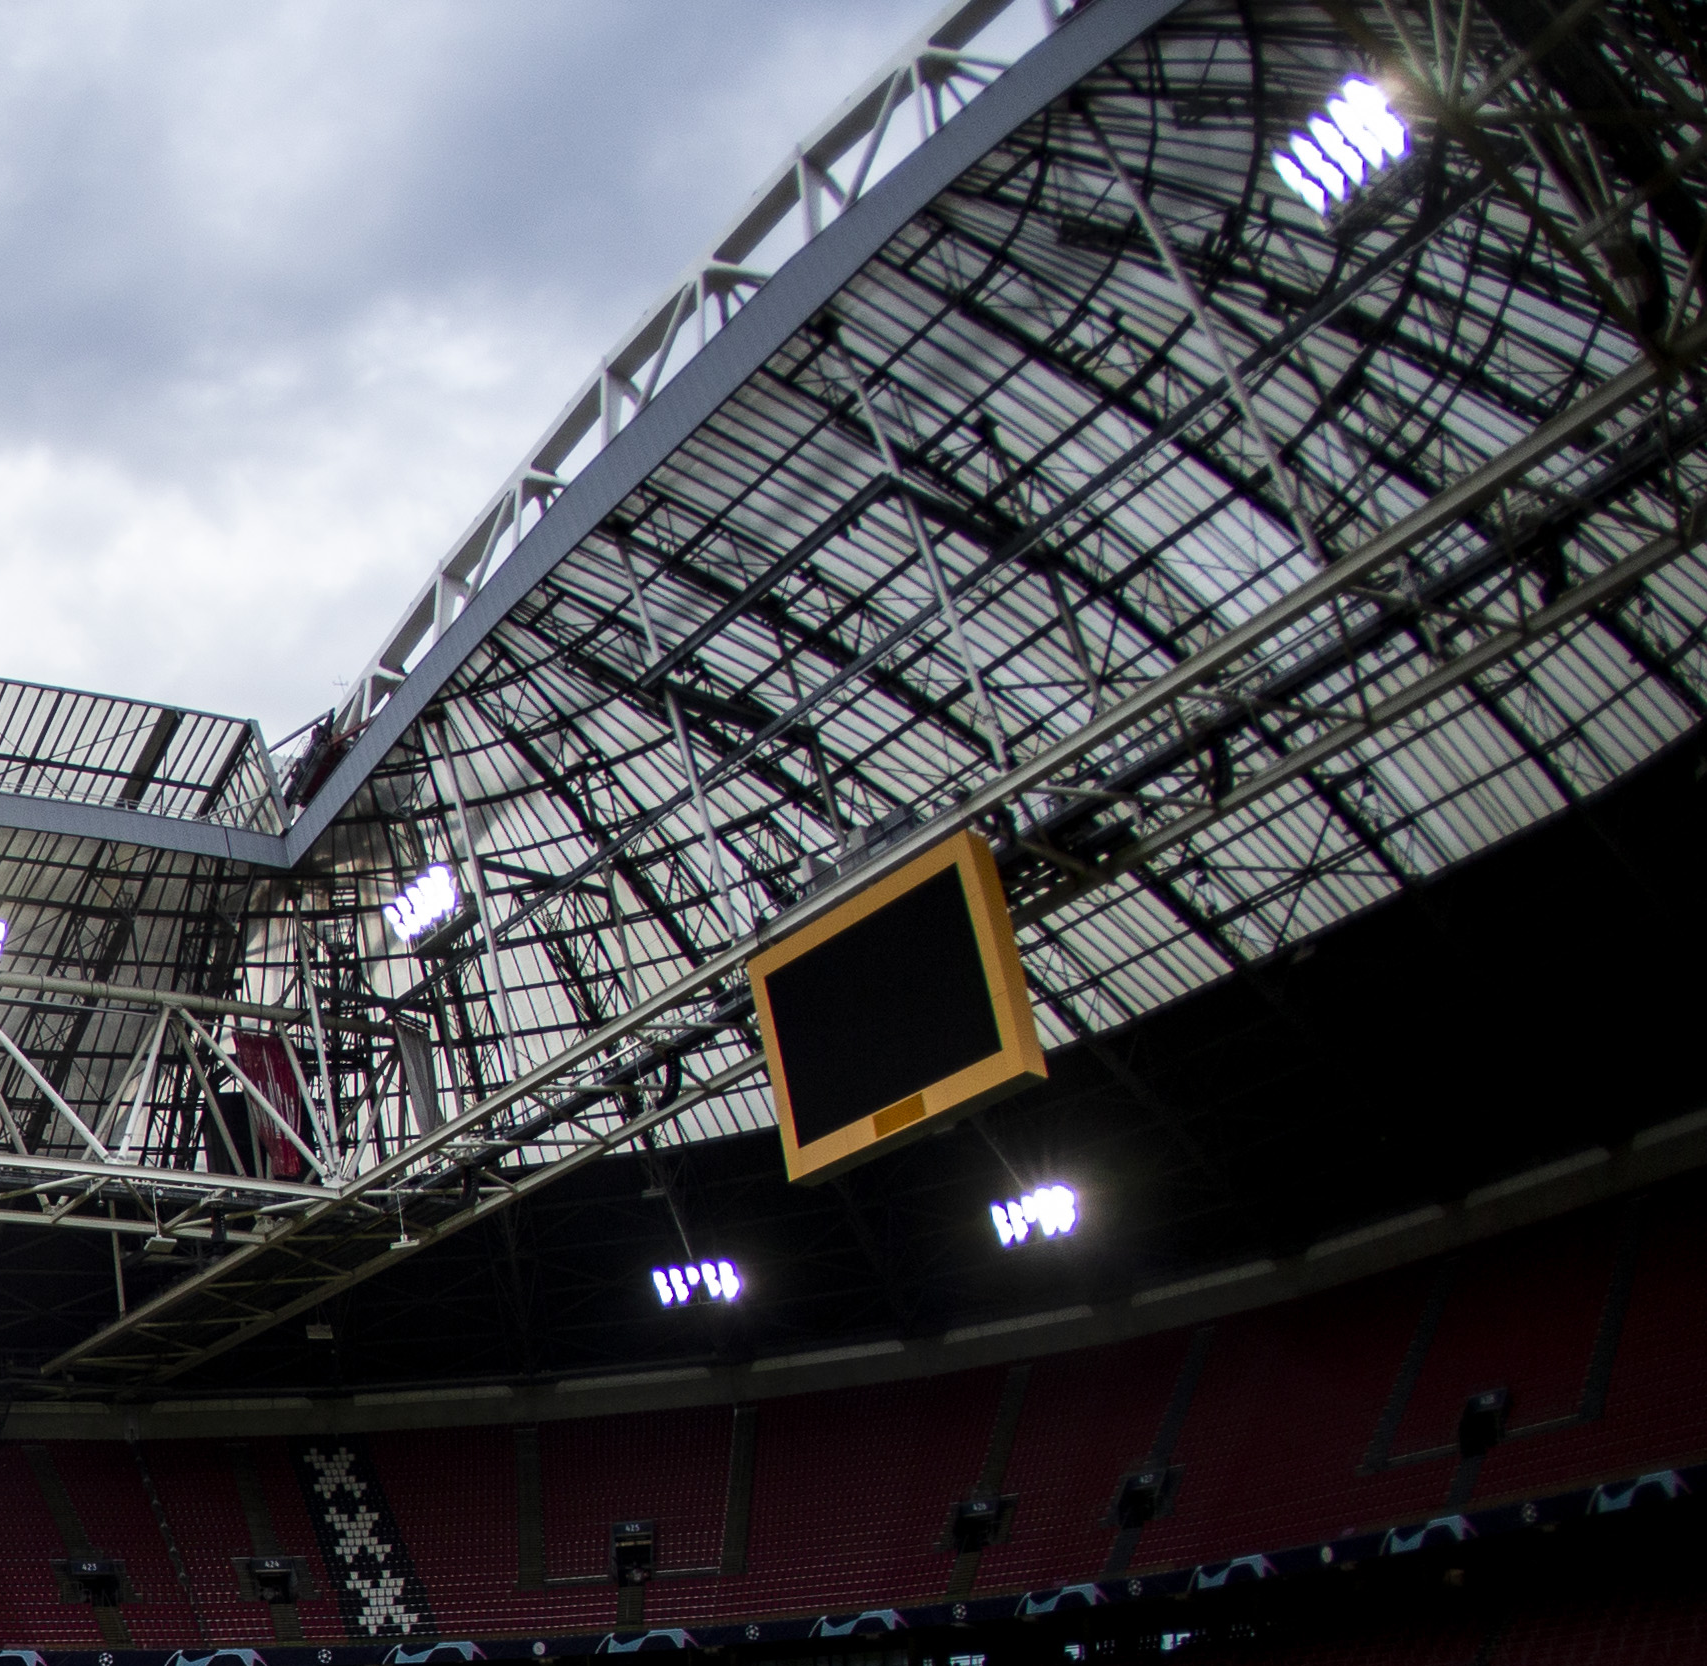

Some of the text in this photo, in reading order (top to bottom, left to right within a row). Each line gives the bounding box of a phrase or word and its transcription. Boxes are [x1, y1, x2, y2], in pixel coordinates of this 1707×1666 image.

[625, 1524, 641, 1532] 425
[81, 1563, 98, 1571] 423
[264, 1560, 281, 1568] 424
